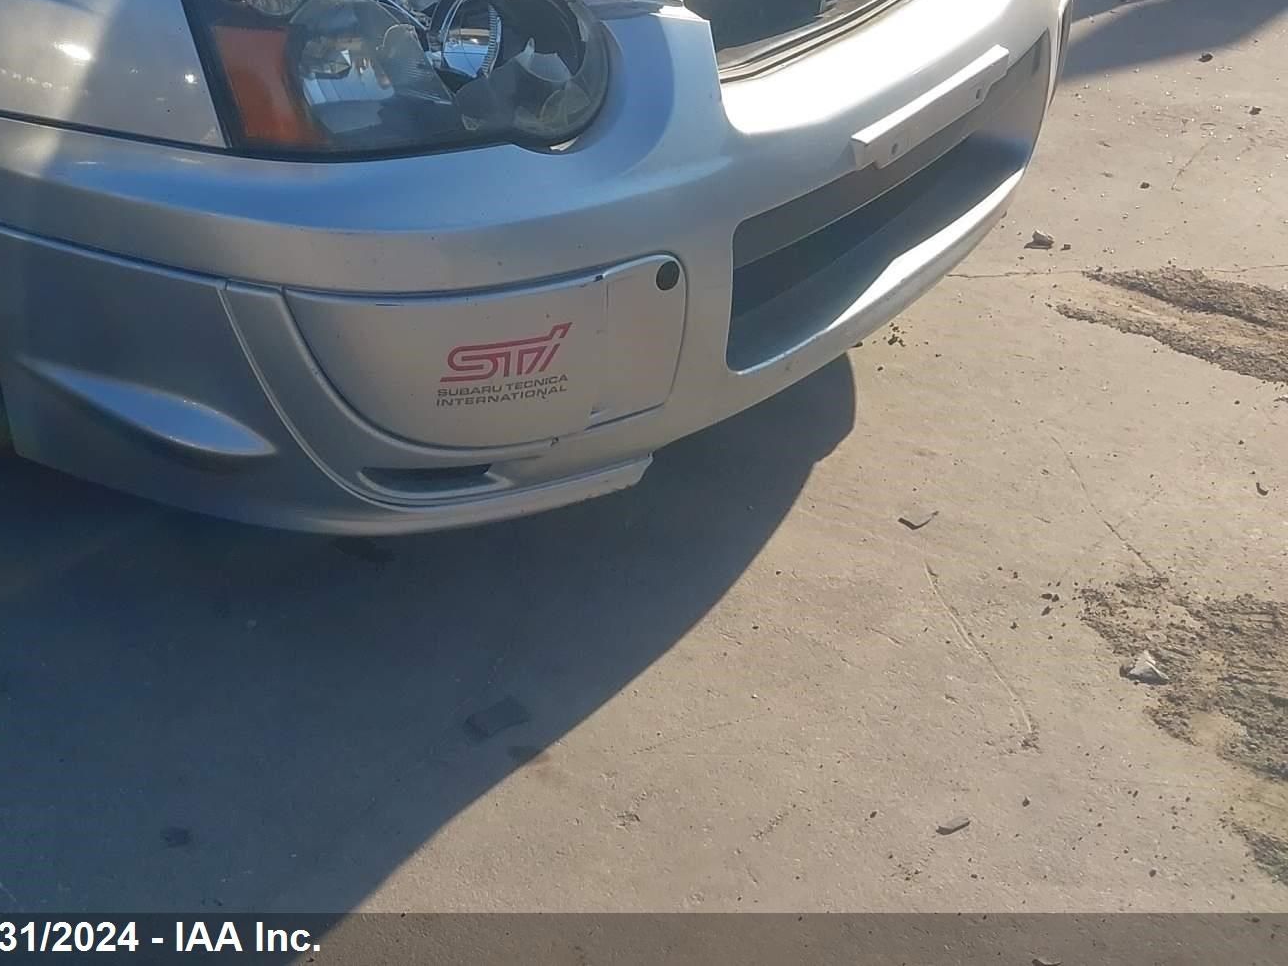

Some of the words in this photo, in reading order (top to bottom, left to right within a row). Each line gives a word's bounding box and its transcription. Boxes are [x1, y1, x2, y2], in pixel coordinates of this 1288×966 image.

[435, 385, 568, 407] INTERNATIONAL
[437, 384, 502, 398] SUBARU
[506, 373, 569, 390] TECNICA
